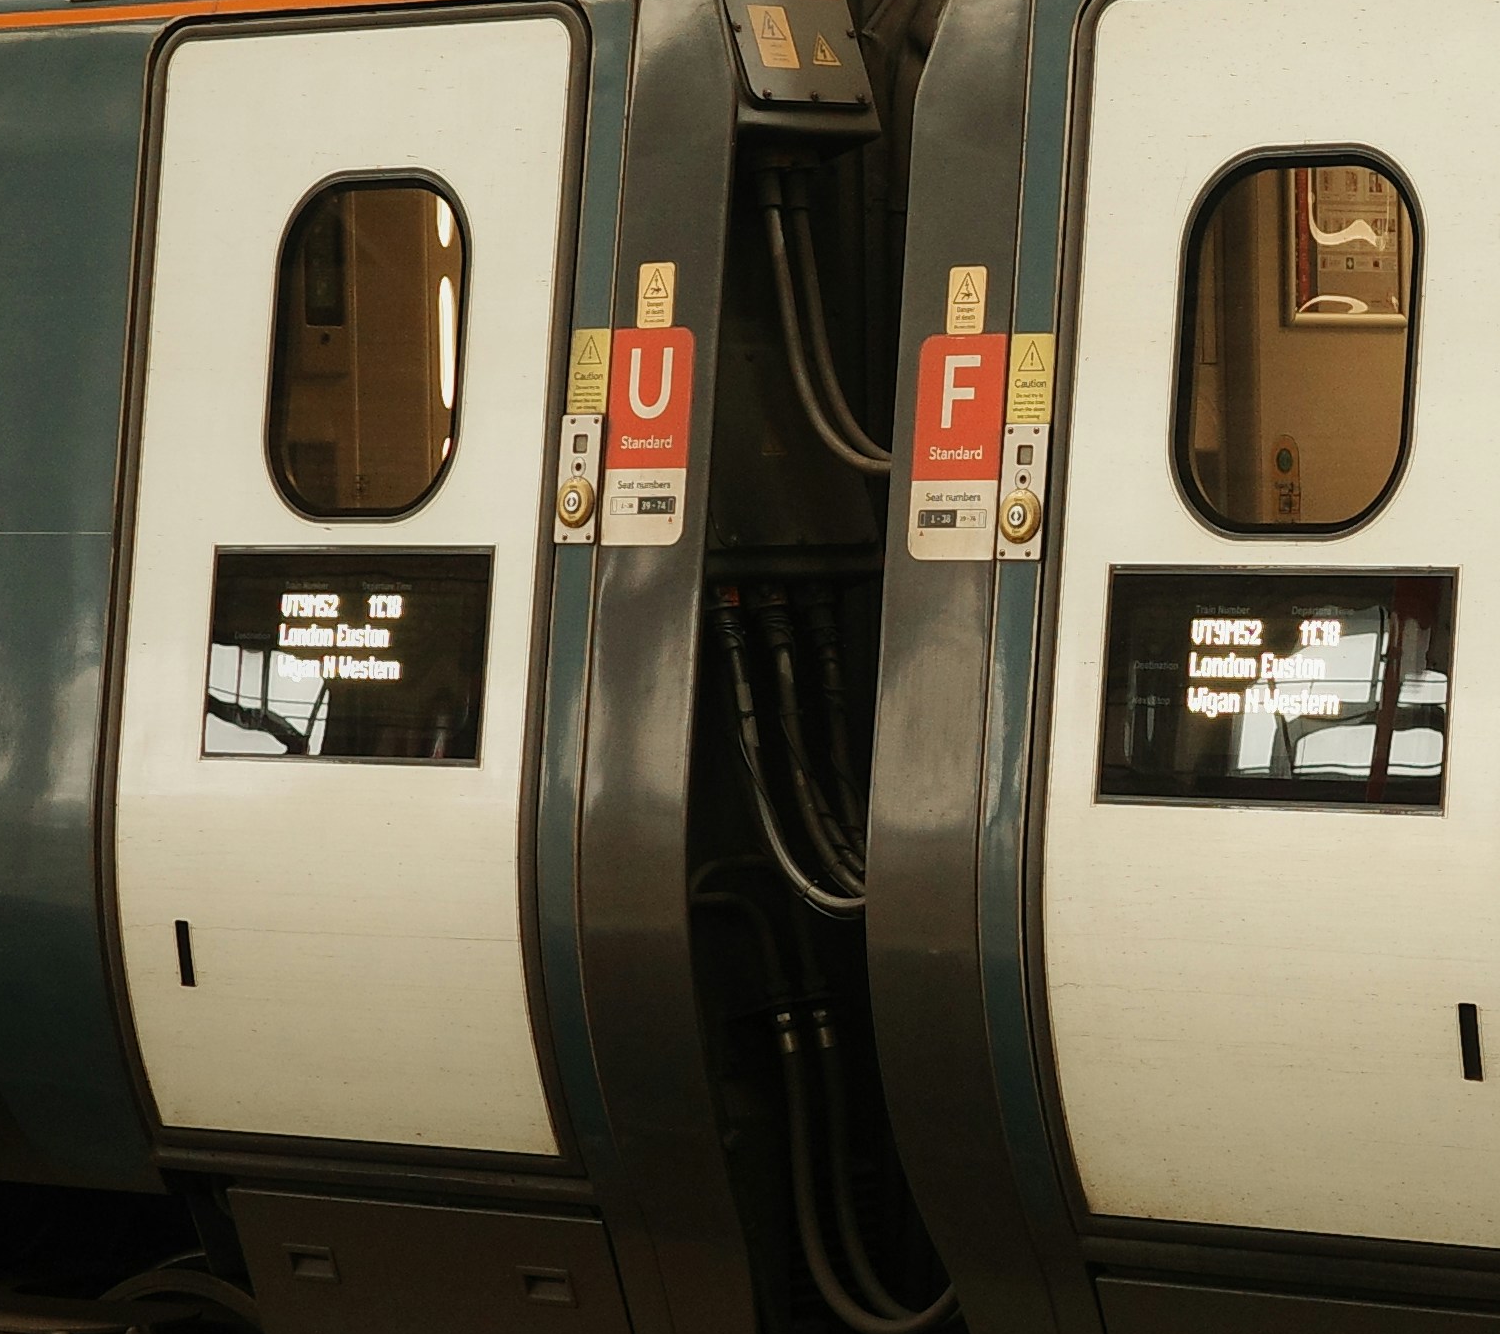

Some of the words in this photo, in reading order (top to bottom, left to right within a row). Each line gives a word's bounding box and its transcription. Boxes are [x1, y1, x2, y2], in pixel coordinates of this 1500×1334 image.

[574, 371, 603, 381] Caution
[629, 348, 674, 419] U
[1014, 378, 1047, 388] Caution
[941, 354, 982, 429] F
[620, 435, 673, 450] Standard
[929, 446, 983, 461] Standard
[617, 480, 634, 489] Seat
[636, 480, 671, 489] numbers
[925, 492, 943, 502] Seat
[945, 492, 981, 502] numbers
[1195, 604, 1216, 614] Train
[1218, 605, 1250, 615] Number
[279, 623, 334, 647] London
[336, 624, 390, 648] Euston
[277, 654, 320, 682] Wigan
[323, 655, 336, 679] N
[339, 656, 401, 680] Western
[1189, 651, 1257, 677] London
[1261, 652, 1326, 679] Euston
[1187, 687, 1241, 717] Wigan
[1244, 688, 1259, 714] N
[1263, 688, 1341, 715] Western
